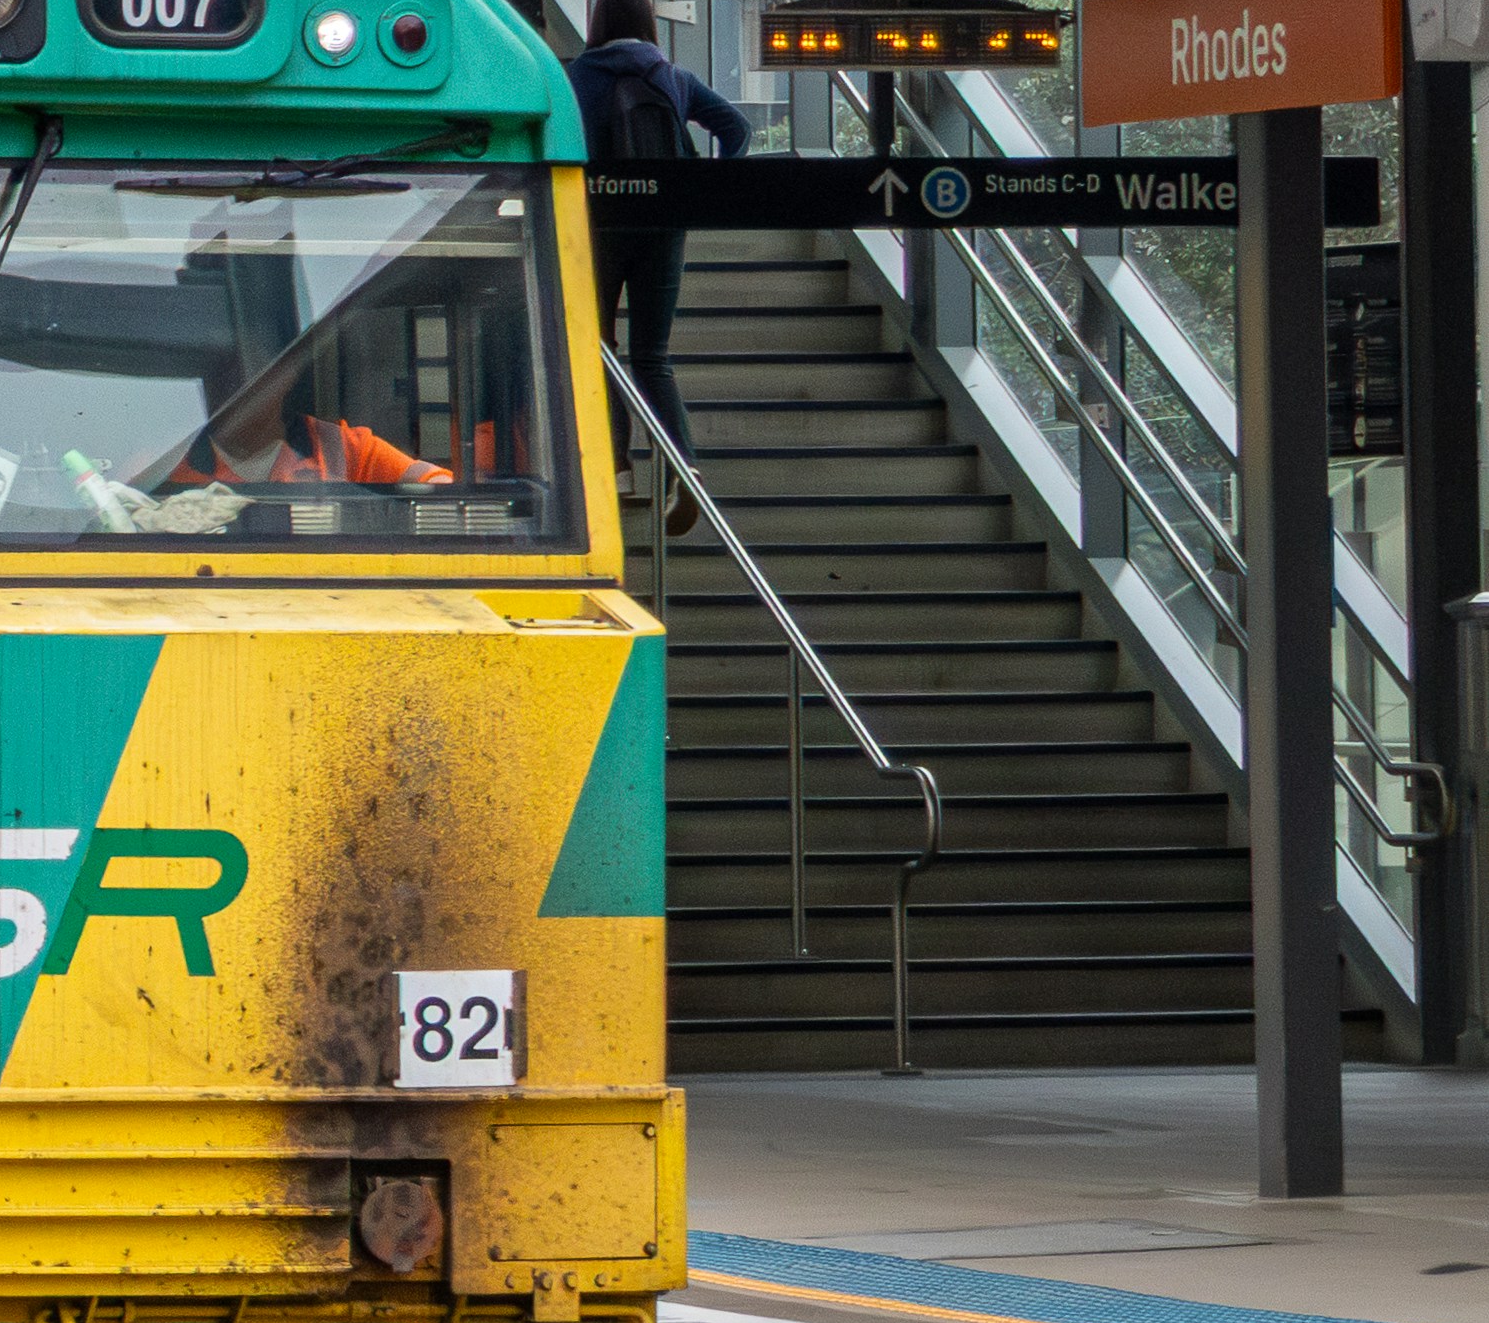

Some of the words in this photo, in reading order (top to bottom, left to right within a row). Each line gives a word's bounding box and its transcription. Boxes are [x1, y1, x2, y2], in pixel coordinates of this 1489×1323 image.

[1170, 8, 1288, 86] Rhodes
[587, 174, 659, 195] tforms
[984, 174, 1057, 194] Stands
[1114, 173, 1238, 211] Walke
[412, 995, 499, 1063] 82
